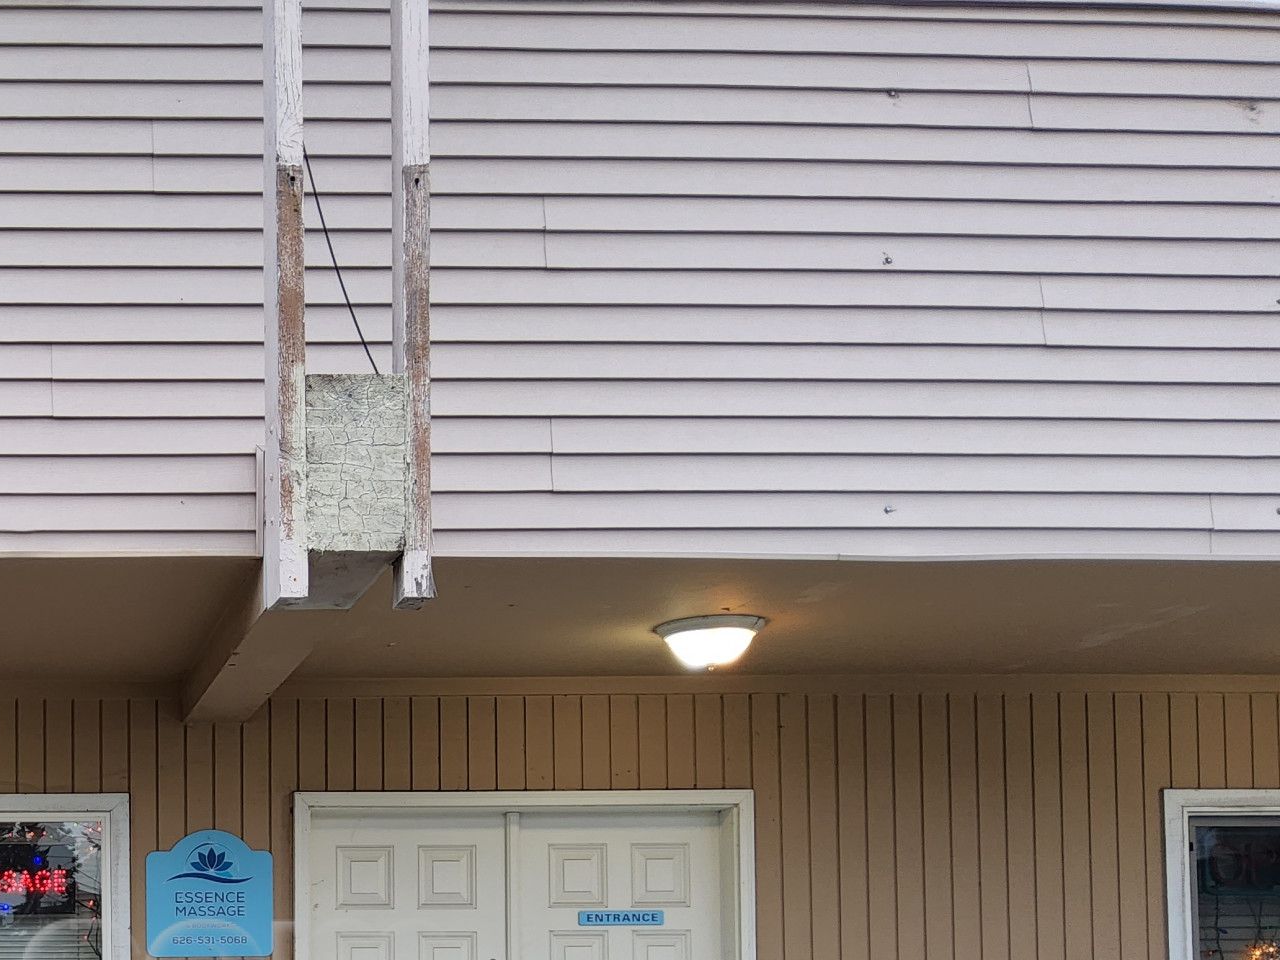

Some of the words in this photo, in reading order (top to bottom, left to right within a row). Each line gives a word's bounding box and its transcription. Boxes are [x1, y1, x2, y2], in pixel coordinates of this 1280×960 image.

[175, 891, 246, 903] ESSENCE
[175, 905, 246, 917] MASSAGE
[586, 913, 659, 922] ENTRANCE
[172, 936, 248, 945] 626-531-5068
